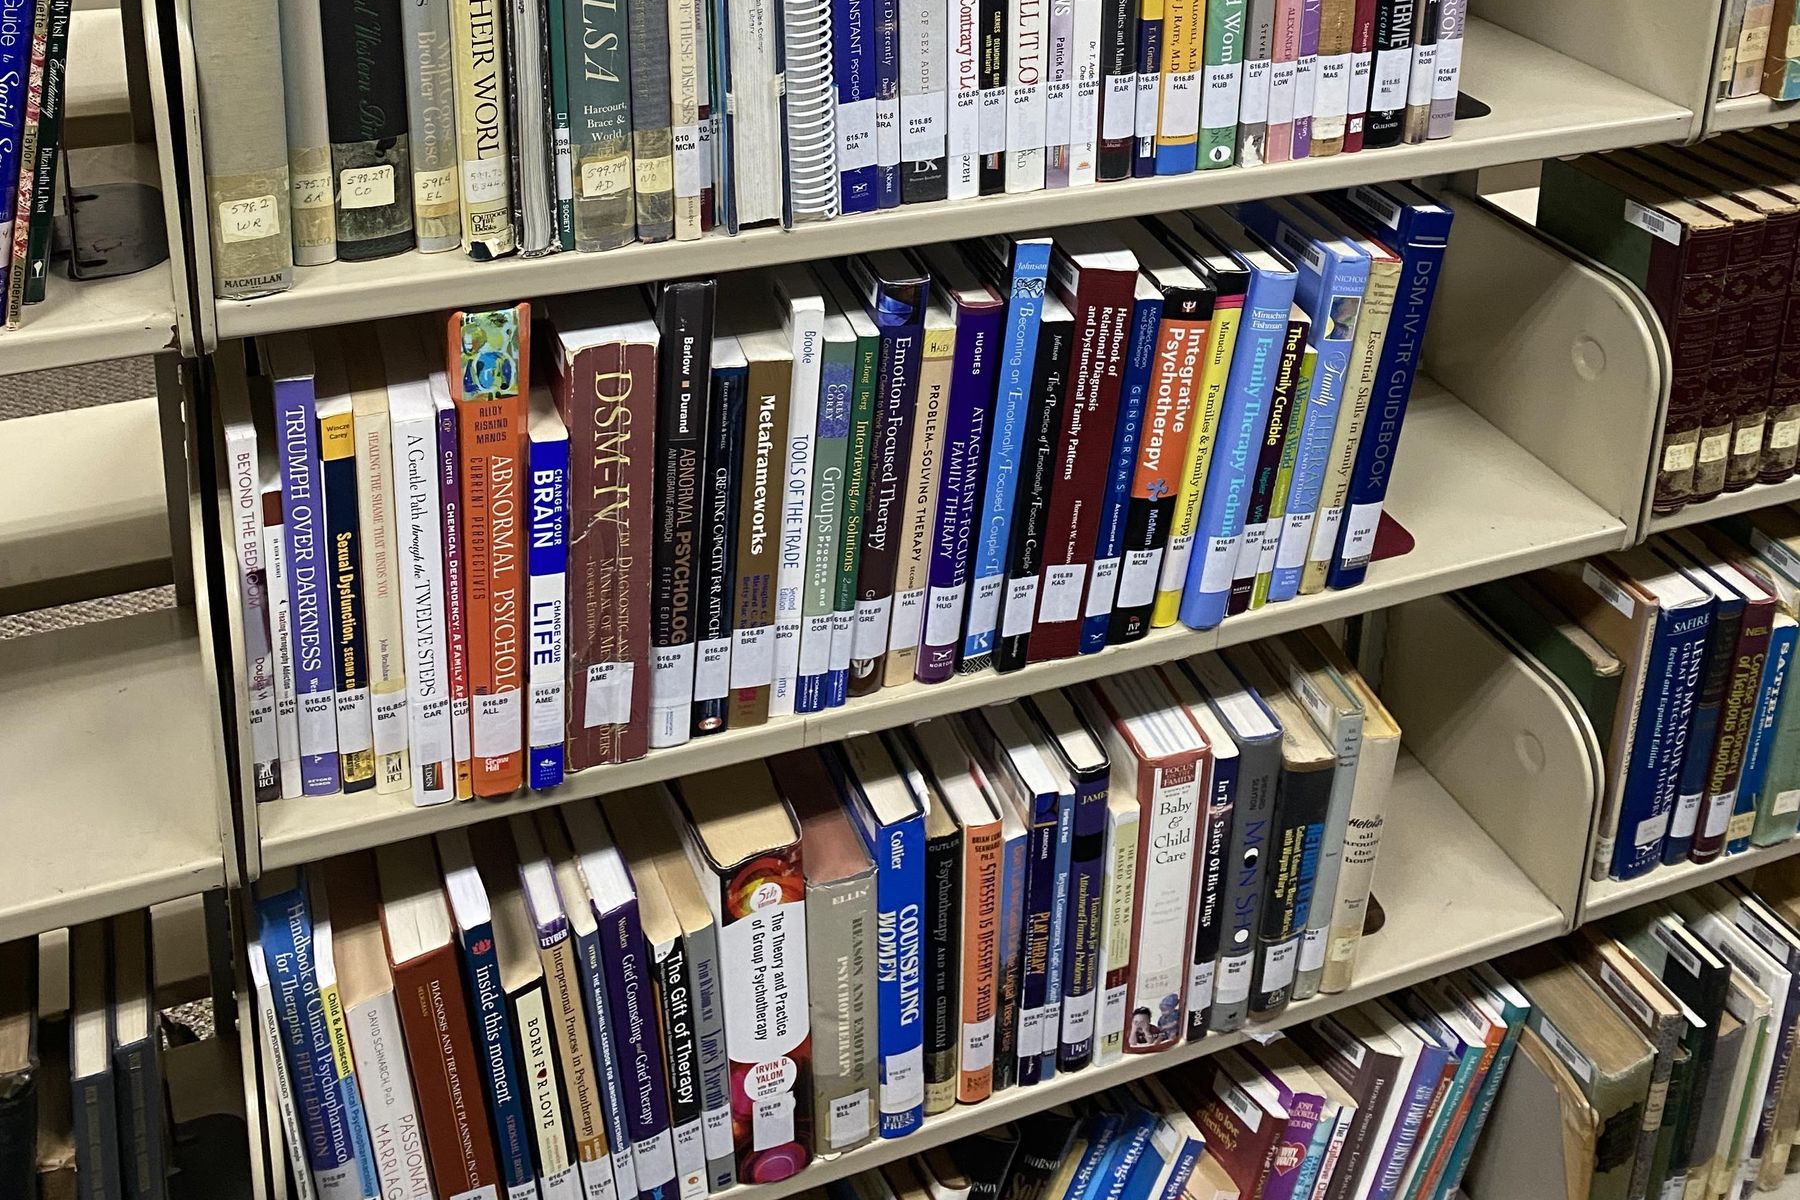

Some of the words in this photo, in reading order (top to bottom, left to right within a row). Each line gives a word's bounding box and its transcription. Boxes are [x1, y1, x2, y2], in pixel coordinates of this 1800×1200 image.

[584, 102, 626, 116] Harcourt,
[24, 132, 37, 164] Taylor
[675, 143, 696, 151] MCM
[846, 132, 868, 141] 615.78
[910, 126, 926, 134] CAR
[224, 272, 282, 288] MACMILLAN
[1016, 262, 1047, 271] Johnson
[10, 265, 24, 317] Zondervan
[1214, 321, 1230, 365] Minuchin
[1252, 320, 1283, 330] Fishman
[682, 337, 694, 375] Barlow
[802, 330, 816, 364] Brooke
[972, 332, 984, 375] HUGHES
[1143, 327, 1186, 471] Psychotherapy
[1172, 328, 1205, 433] Integrative
[479, 406, 503, 417] ALLOY
[679, 393, 691, 433] Durand
[881, 337, 911, 483] Emotion-Focused
[1367, 370, 1407, 489] GUIDEBOOK
[286, 405, 310, 499] TRIUMPH
[476, 432, 507, 444] MANOS
[444, 451, 453, 485] CURTIS
[750, 395, 776, 556] Metaframeworks
[1064, 437, 1078, 480] Patterns
[491, 455, 515, 579] ABNORMAL
[533, 469, 555, 549] BRAIN
[296, 568, 321, 672] DARKNESS
[414, 579, 431, 646] TWELVE
[533, 601, 552, 665] LIFE
[419, 648, 436, 696] STEPS
[536, 696, 553, 704] AME
[1160, 799, 1192, 816] Baby
[1168, 817, 1182, 829] &
[891, 830, 904, 870] Collier
[1154, 829, 1190, 849] Child
[1156, 851, 1186, 864] Care
[1203, 895, 1216, 928] Wings
[541, 929, 567, 948] TEYBER
[879, 911, 896, 982] WOMEN
[668, 952, 681, 985] The
[900, 903, 920, 1025] COUNSELING
[476, 964, 494, 1010] inside
[669, 988, 685, 1019] Gift
[751, 966, 767, 1041] Psychotherapy
[675, 1022, 686, 1036] of
[774, 992, 788, 1037] Practice
[528, 1017, 543, 1057] BORN
[539, 1092, 554, 1130] LOVE
[677, 1038, 693, 1104] Therapy
[756, 1072, 784, 1084] YALOM
